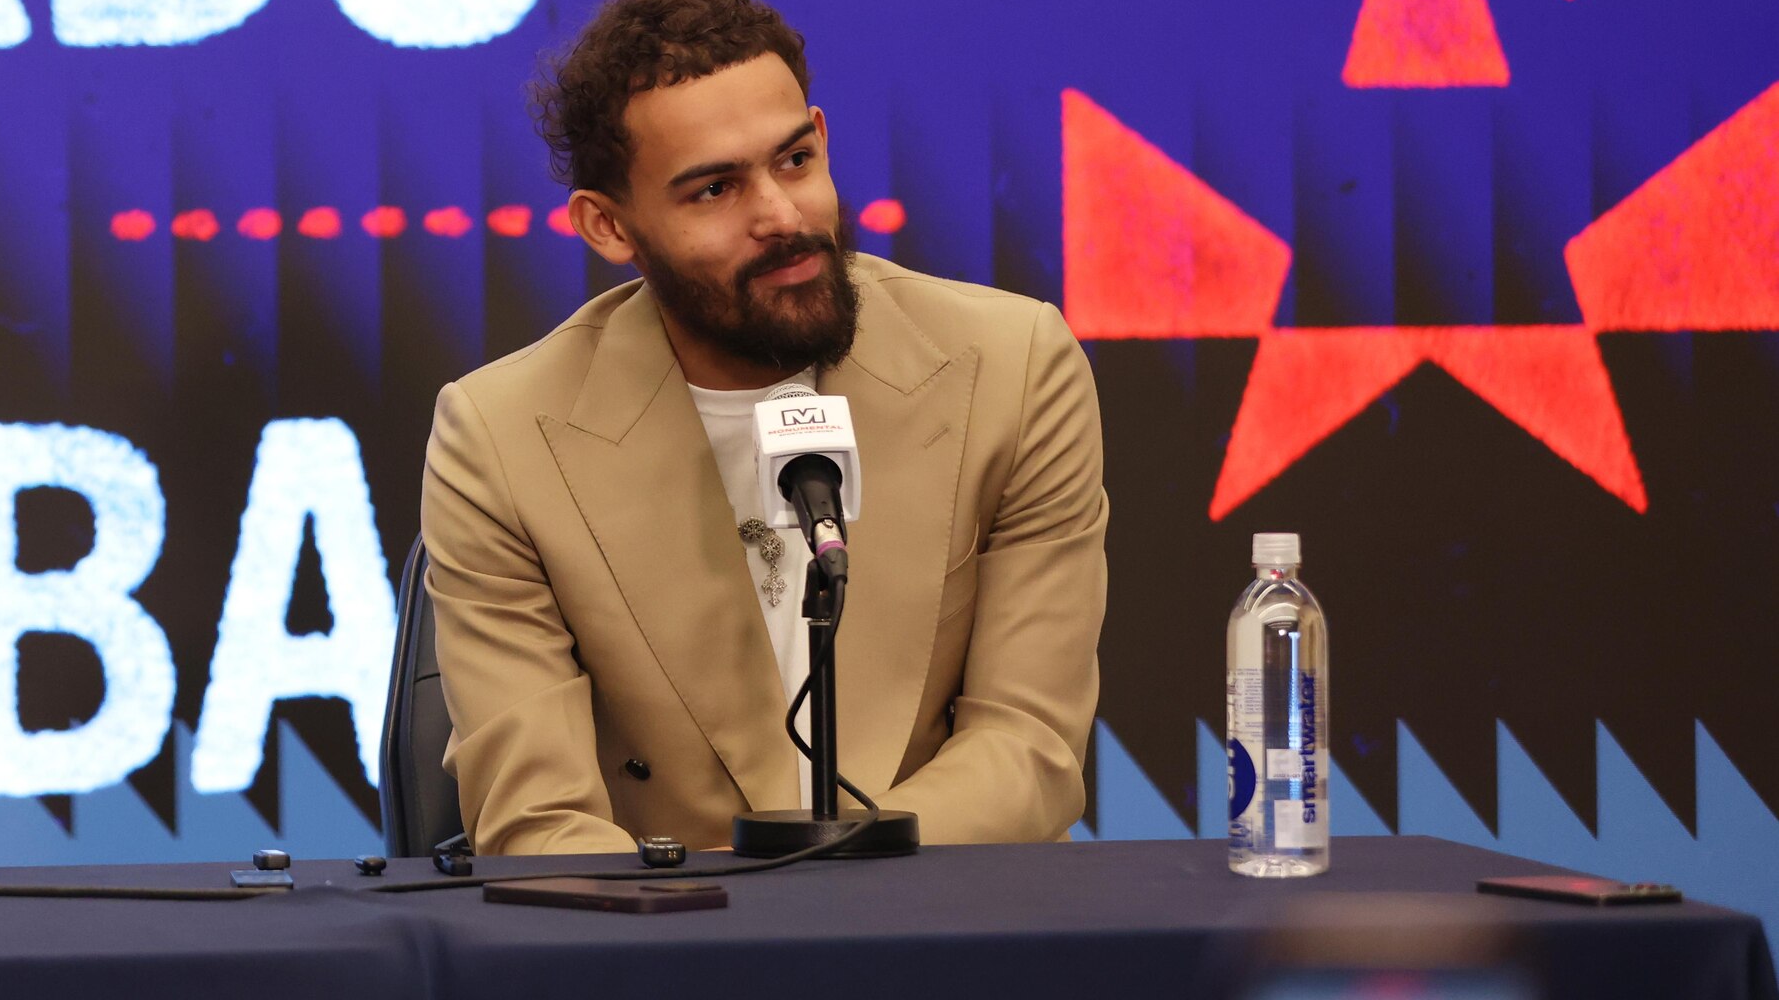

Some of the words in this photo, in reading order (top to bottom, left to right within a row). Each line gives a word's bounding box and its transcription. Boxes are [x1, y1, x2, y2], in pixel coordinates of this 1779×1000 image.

[781, 407, 826, 426] M
[768, 425, 844, 435] MONUMENTAL
[1301, 672, 1316, 824] smartwater
